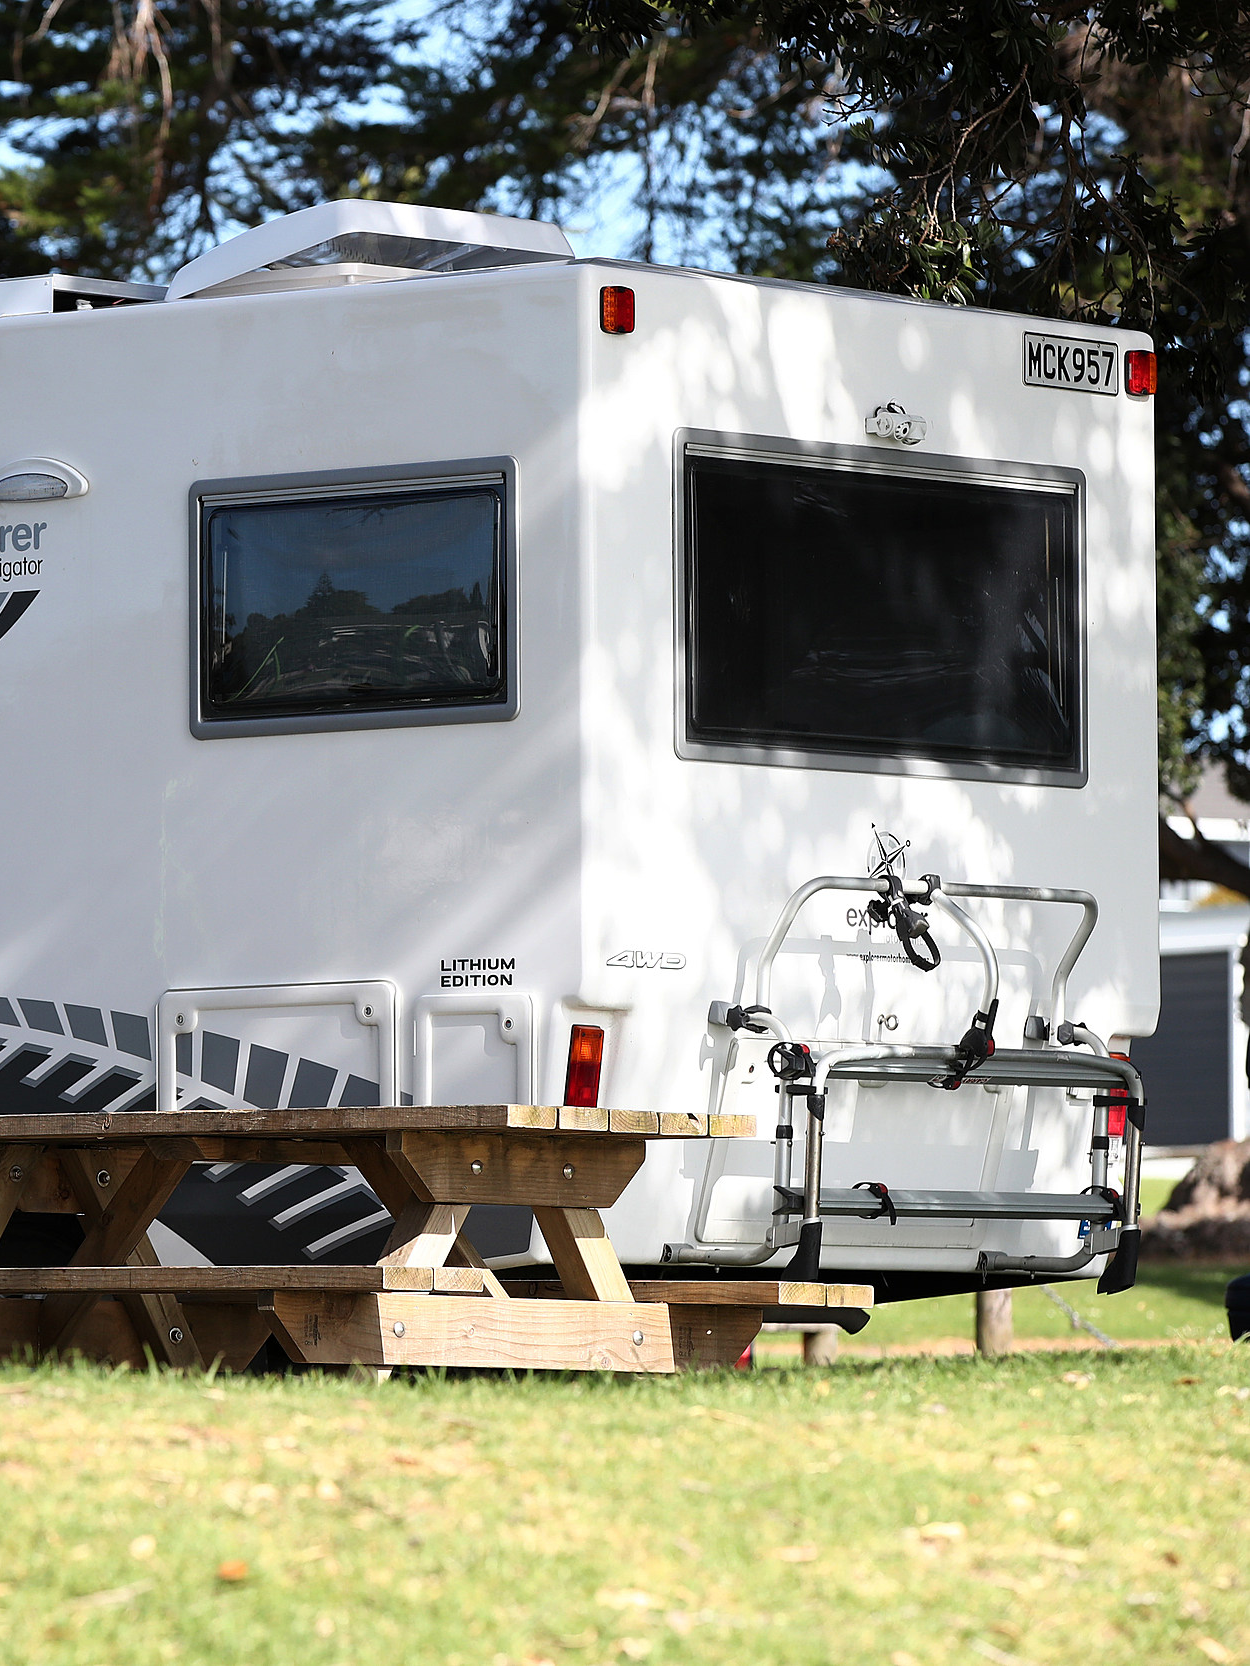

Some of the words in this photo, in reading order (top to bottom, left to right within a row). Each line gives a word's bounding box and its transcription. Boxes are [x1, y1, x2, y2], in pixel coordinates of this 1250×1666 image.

[1028, 341, 1114, 387] MCK957
[440, 957, 515, 972] LITHIUM
[606, 949, 687, 970] 4WD
[440, 973, 513, 988] EDITION
